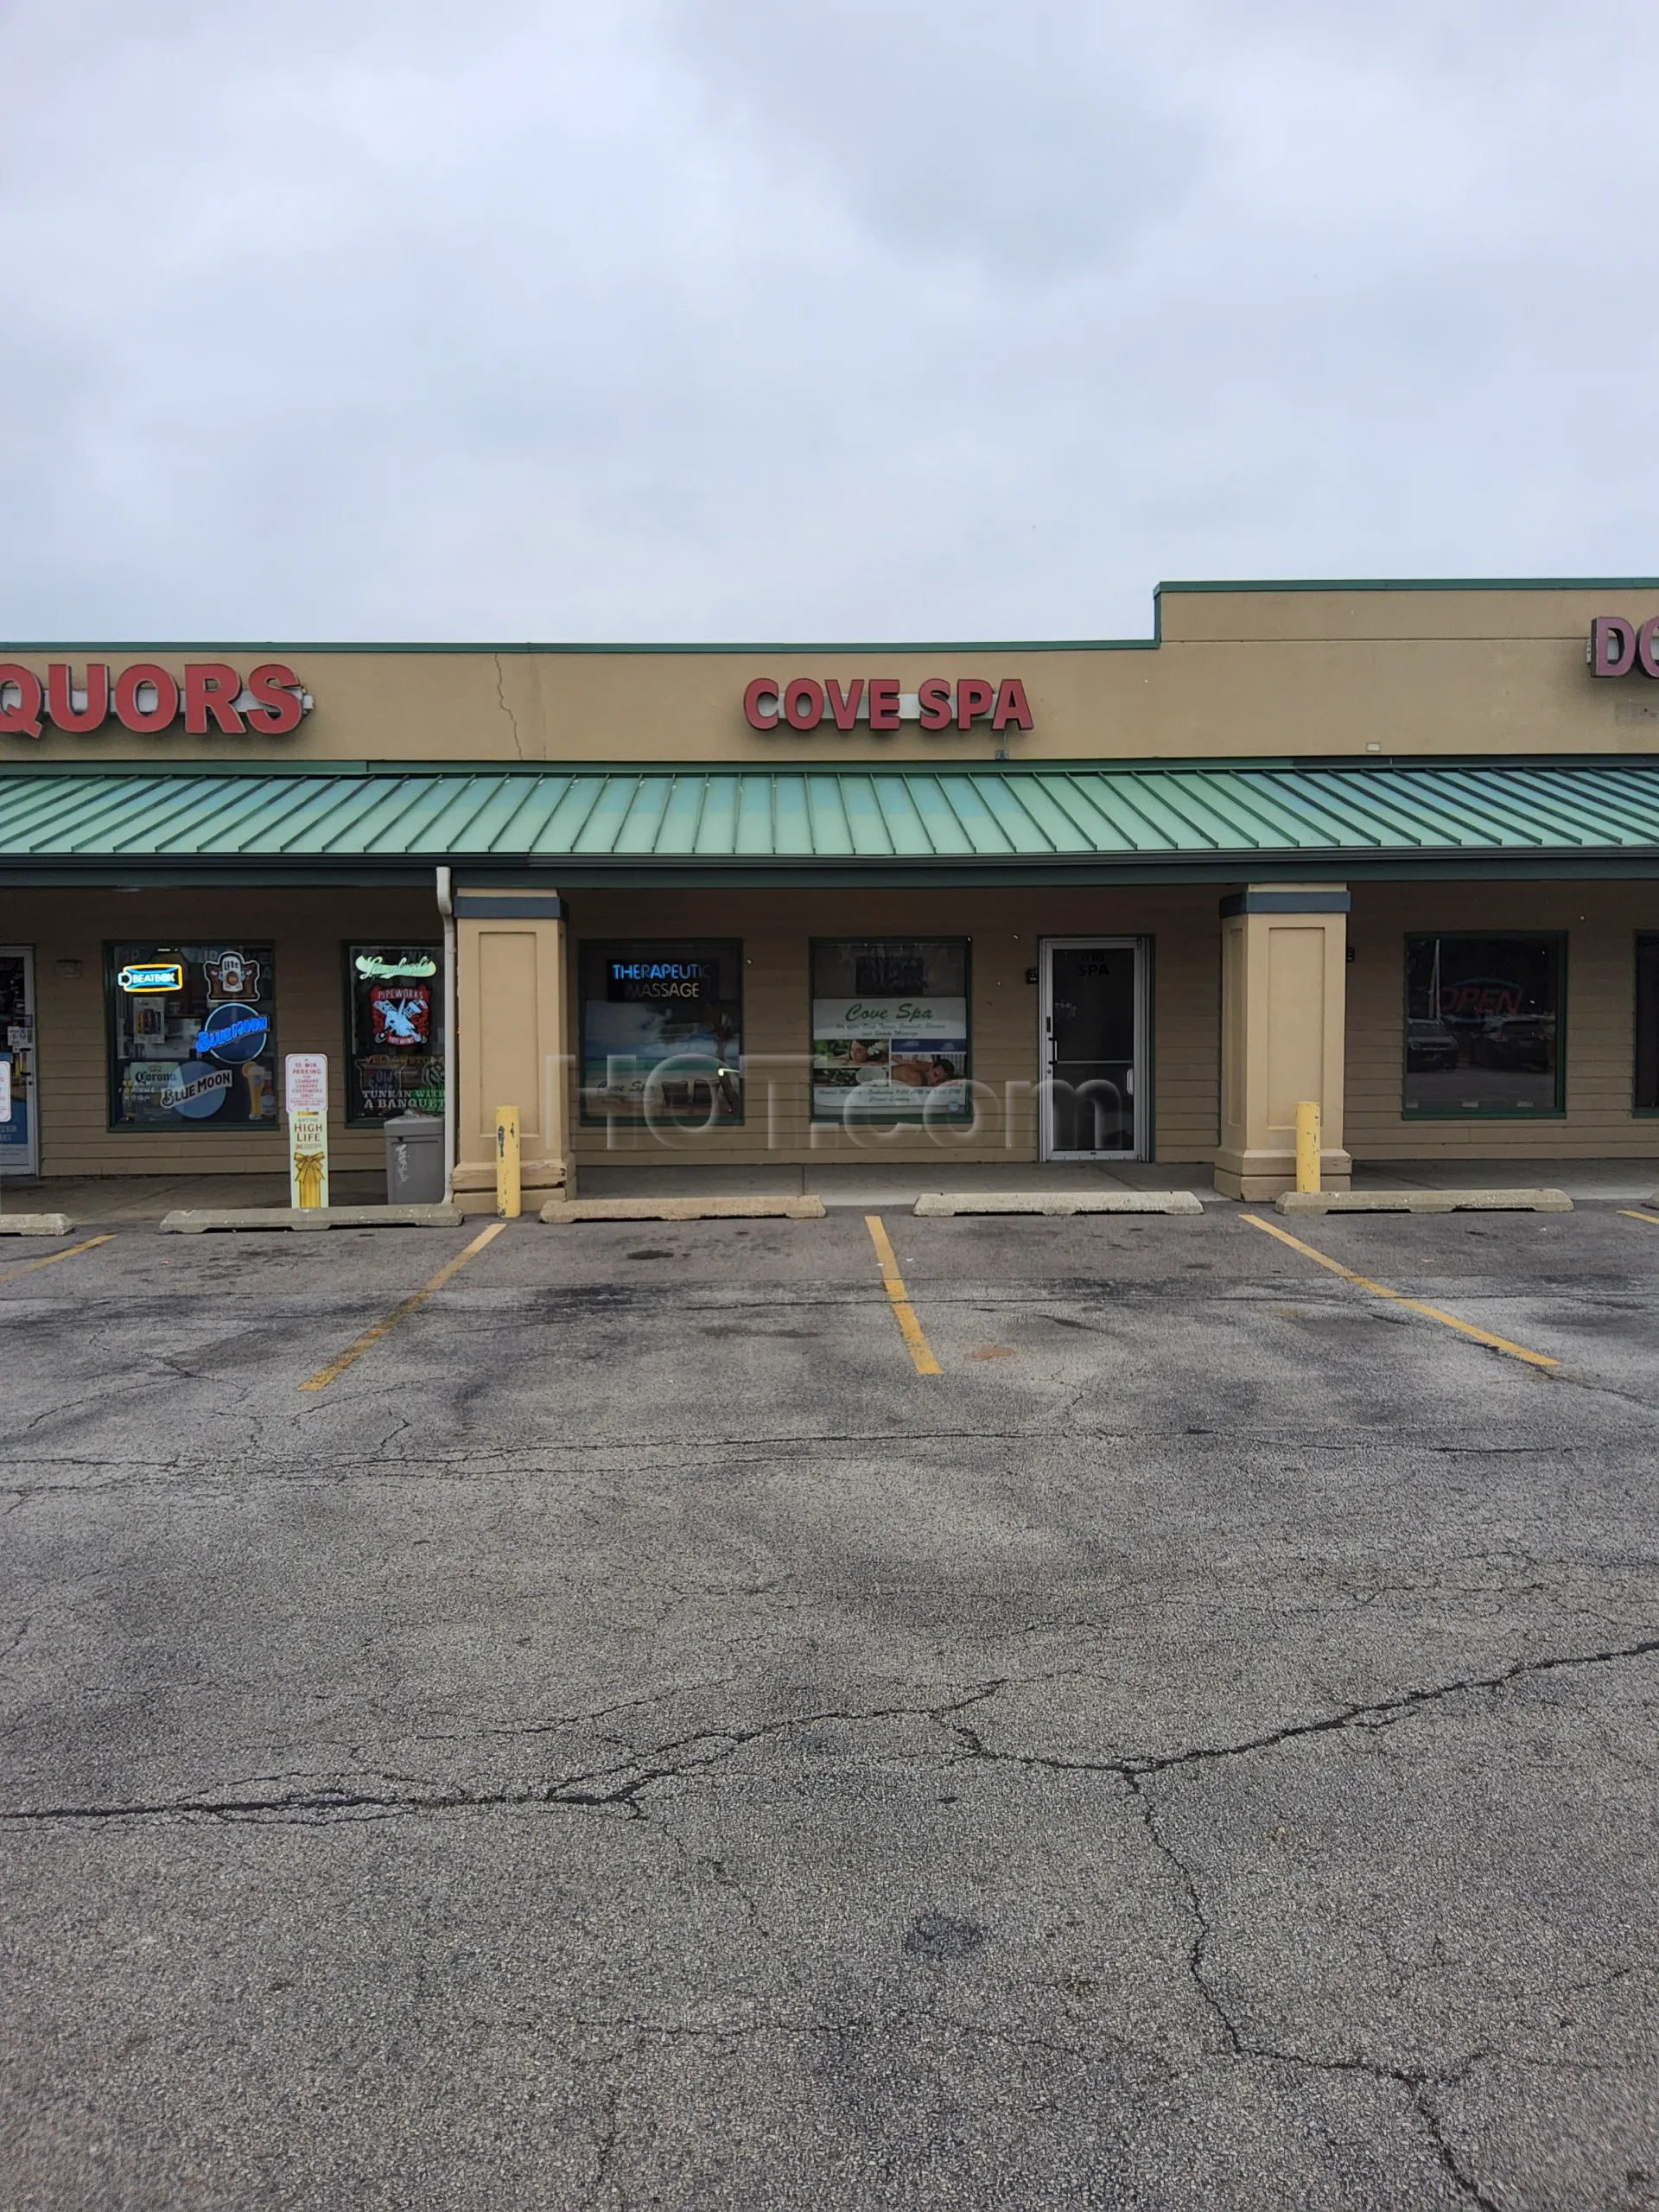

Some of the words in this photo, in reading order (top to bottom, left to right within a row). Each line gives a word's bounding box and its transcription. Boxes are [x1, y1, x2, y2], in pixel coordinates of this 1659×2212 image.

[0, 664, 302, 739] QUORS
[744, 677, 900, 730] COVE
[918, 677, 1034, 731] SPA
[224, 960, 239, 969] Lite
[1077, 964, 1110, 976] SPA
[132, 971, 175, 983] BEATBOX
[612, 964, 712, 980] THERAPEUTIC
[378, 988, 424, 1000] PIPEWORKS
[625, 982, 700, 998] MASSAGE
[1435, 986, 1522, 1014] OPEN
[845, 1003, 889, 1021] Cove
[895, 1003, 934, 1022] Spa
[195, 1027, 232, 1052] BLUE
[232, 1016, 268, 1039] MOON
[135, 1071, 176, 1084] Corona
[162, 1086, 198, 1107] BLUE
[197, 1072, 231, 1094] MOON
[362, 1090, 396, 1098] TUNE
[398, 1090, 411, 1098] IN
[364, 1099, 373, 1109] A
[294, 1123, 322, 1132] HIGH
[296, 1133, 321, 1141] LIFE
